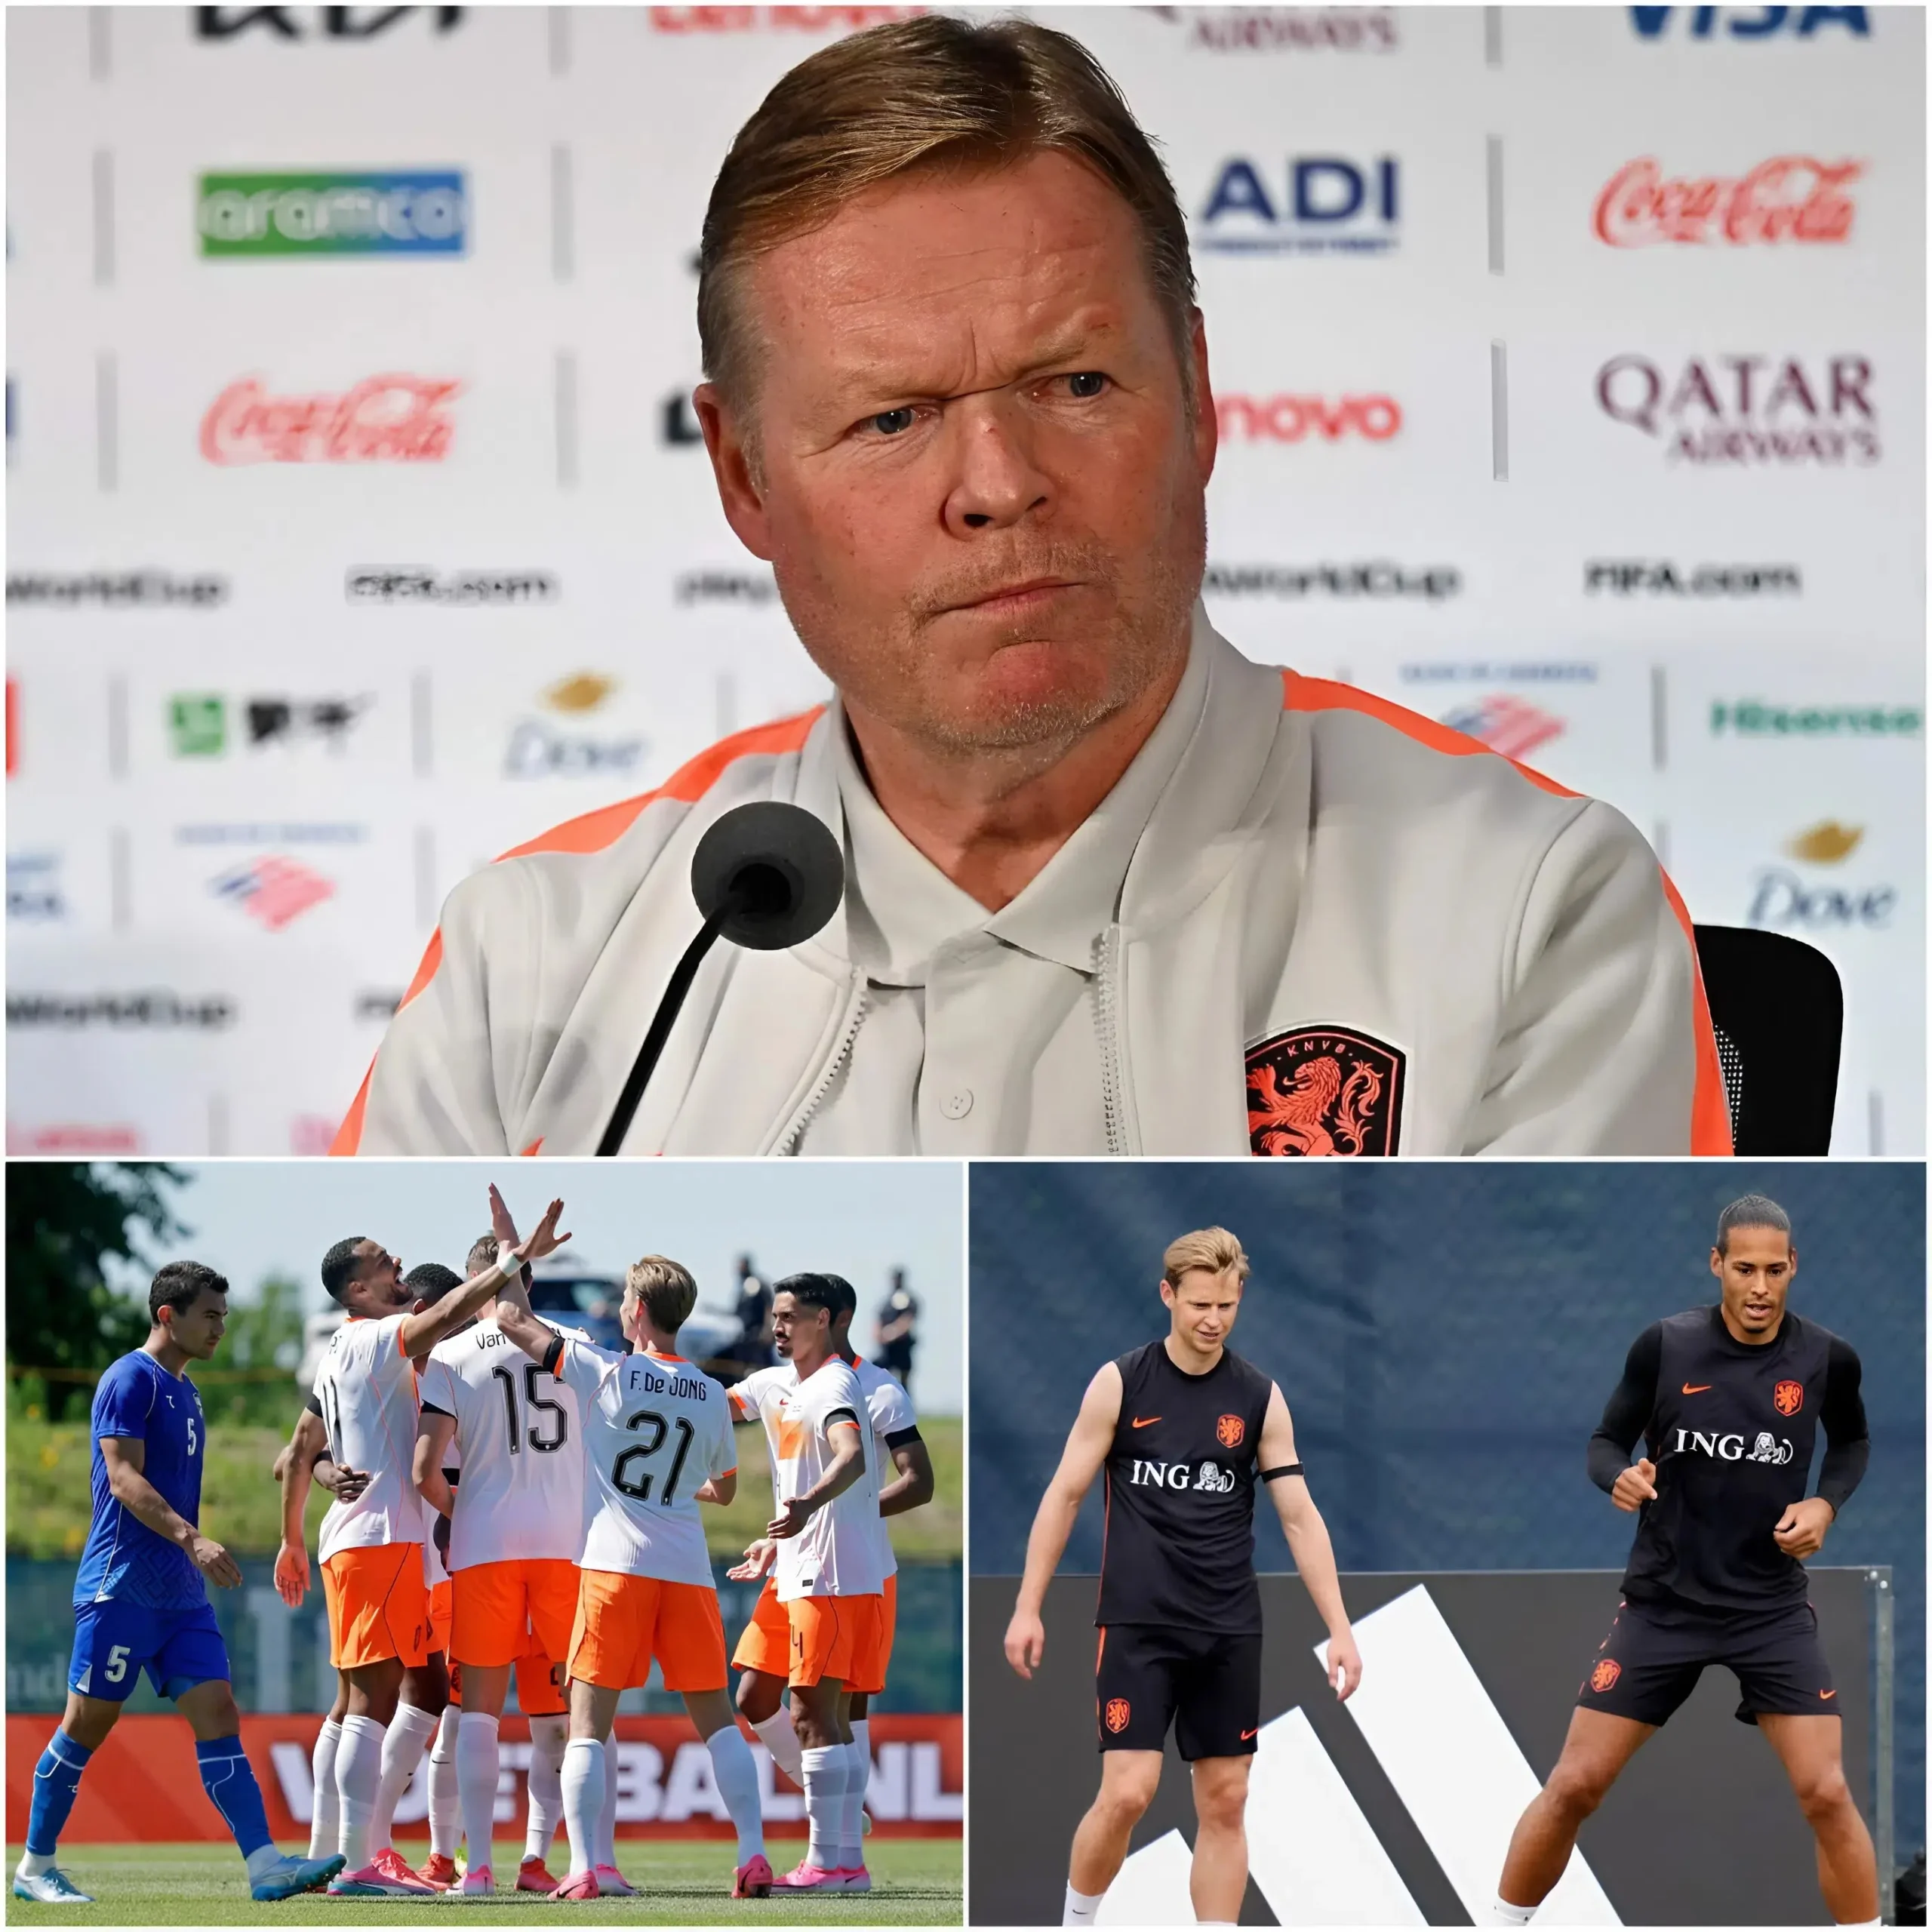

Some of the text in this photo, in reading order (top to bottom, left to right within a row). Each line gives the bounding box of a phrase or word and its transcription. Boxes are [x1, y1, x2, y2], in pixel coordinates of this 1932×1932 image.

[1201, 155, 1401, 224] ADI
[1217, 392, 1402, 444] novo
[1593, 353, 1878, 438] QATAR
[1748, 865, 1897, 931] Dove
[475, 1332, 506, 1349] Van
[491, 1363, 568, 1455] 15
[187, 1417, 197, 1457] 5
[611, 1410, 695, 1506] 21
[1673, 1428, 1745, 1461] ING
[1130, 1459, 1190, 1490] ING
[104, 1644, 131, 1683] 5
